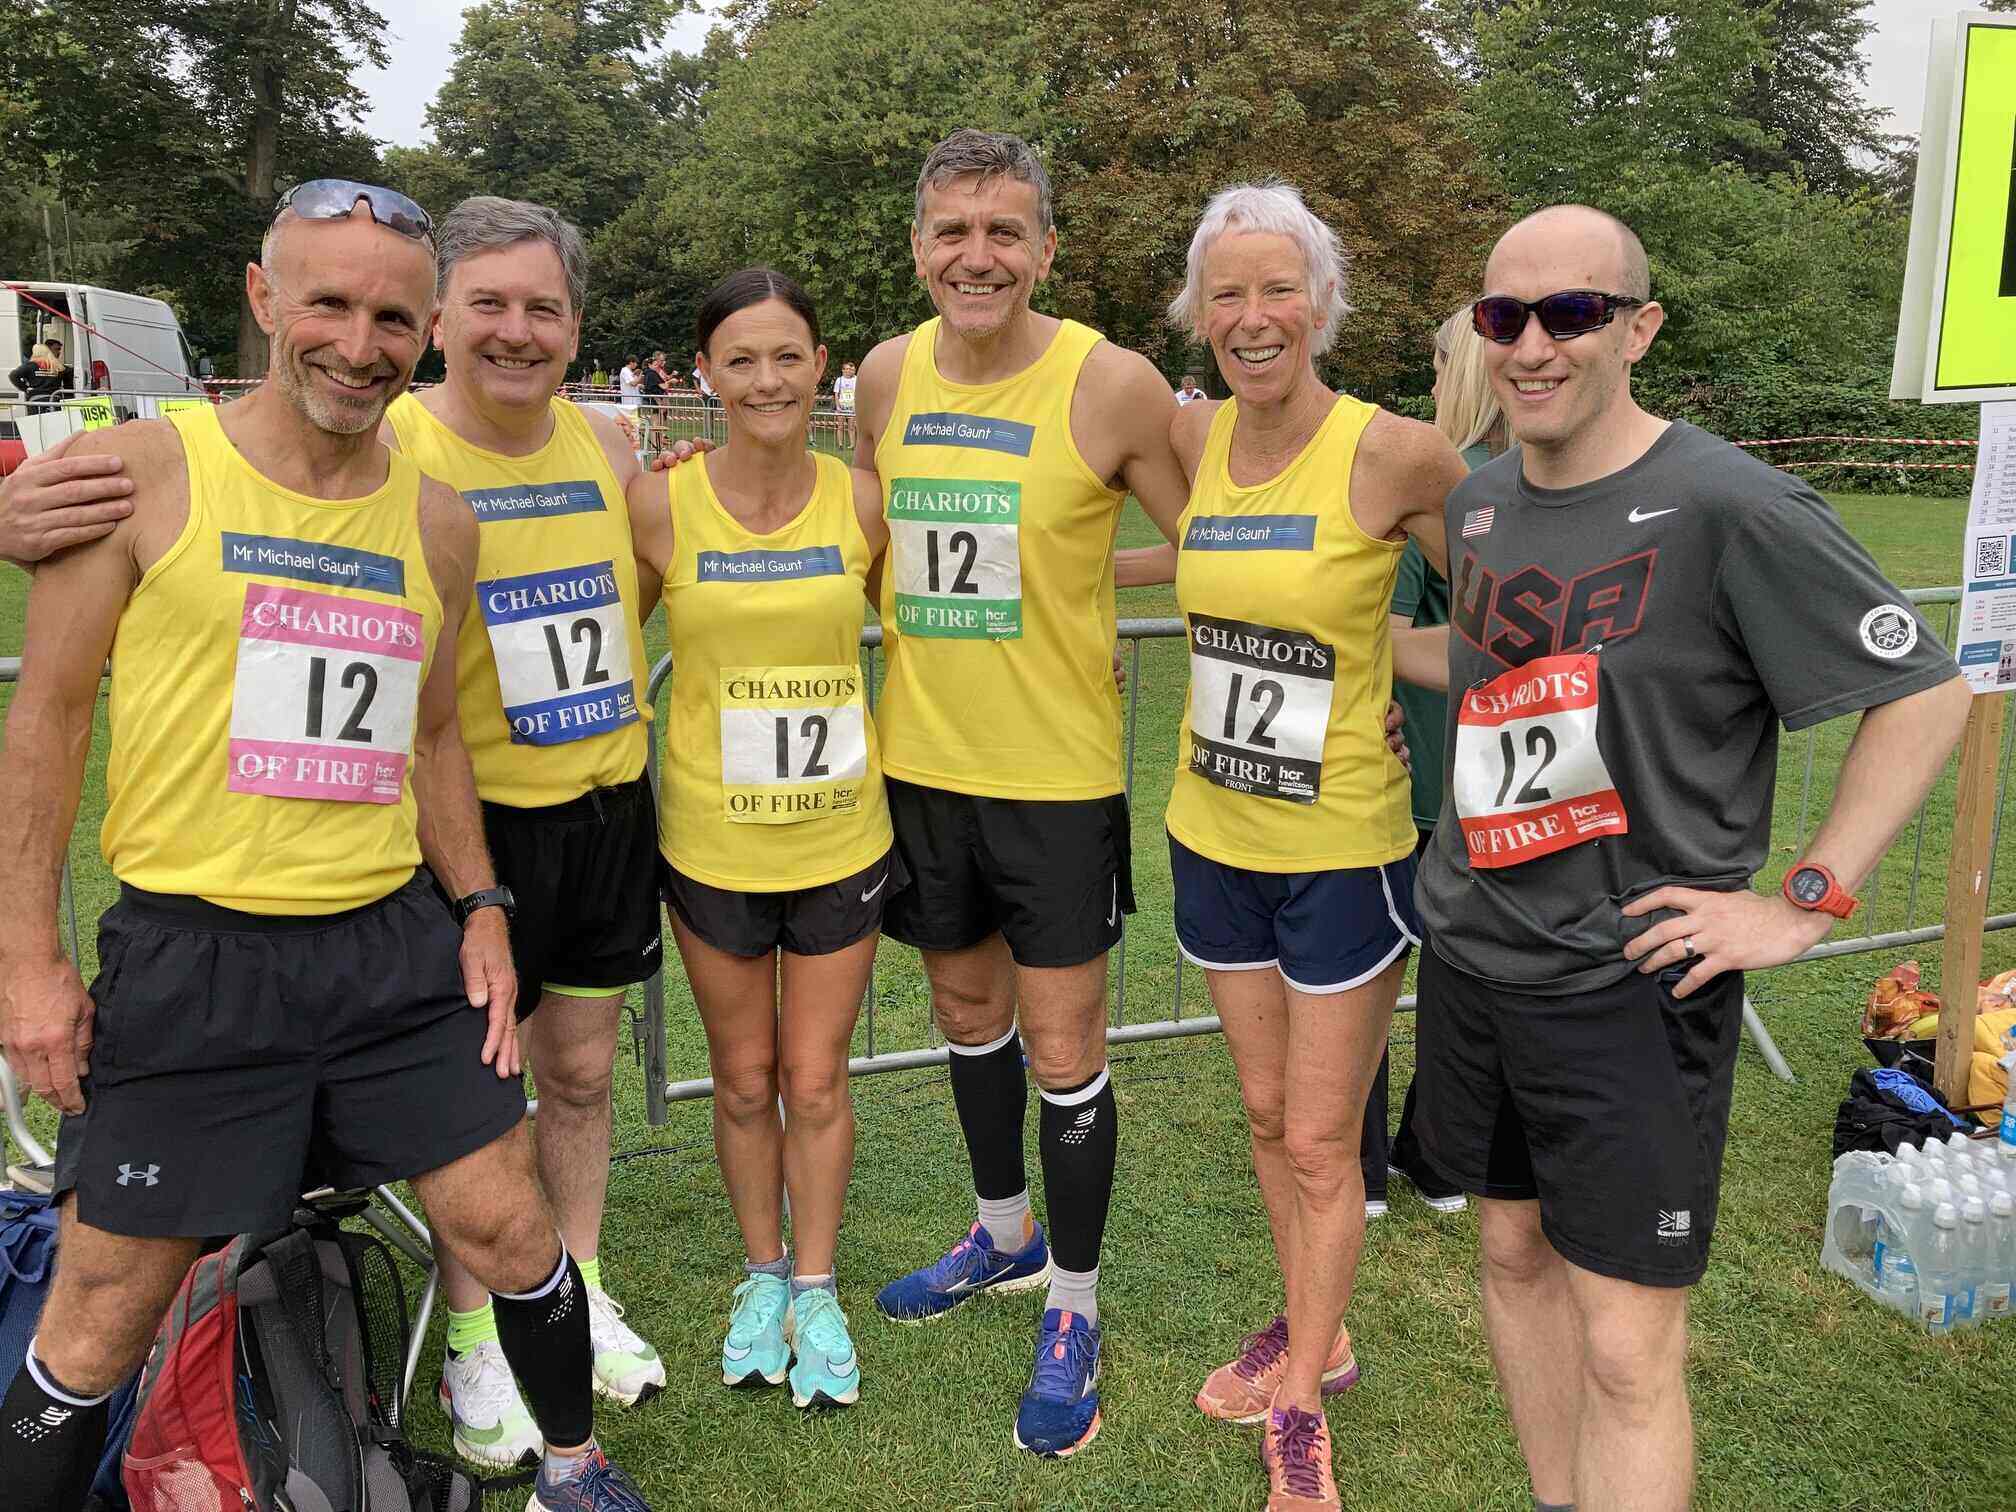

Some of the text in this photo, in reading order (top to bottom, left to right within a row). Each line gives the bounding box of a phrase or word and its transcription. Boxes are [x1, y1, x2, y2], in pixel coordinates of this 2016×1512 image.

[910, 422, 992, 440] Mr Michael Gaunt
[471, 492, 568, 513] Mr Michael Gaunt
[892, 490, 1011, 514] CHARIOTS
[1237, 526, 1271, 541] Gaunt
[233, 544, 360, 577] Mr Michael Gaunt
[704, 559, 802, 575] Mr Michael Gaunt
[927, 530, 979, 594] 12
[488, 573, 615, 614] CHARIOTS
[1453, 548, 1659, 669] USA
[252, 601, 418, 648] CHARIOTS
[899, 604, 978, 628] OF FIRE
[543, 617, 610, 691] 12
[1195, 624, 1328, 670] CHARIOTS
[305, 656, 378, 743] 12
[727, 678, 856, 700] CHARIOTS
[513, 698, 615, 737] OF FIRE
[1223, 672, 1285, 750] 12
[775, 714, 830, 779] 12
[1192, 743, 1271, 785] OF FIRE
[236, 753, 367, 786] OF FIRE
[1279, 766, 1304, 780] hcr
[1493, 725, 1557, 807] 12
[729, 791, 826, 813] OF FIRE
[1225, 778, 1254, 793] FRONT
[1568, 804, 1601, 820] hcr
[1468, 829, 1488, 854] OF
[1490, 814, 1565, 853] FIRE
